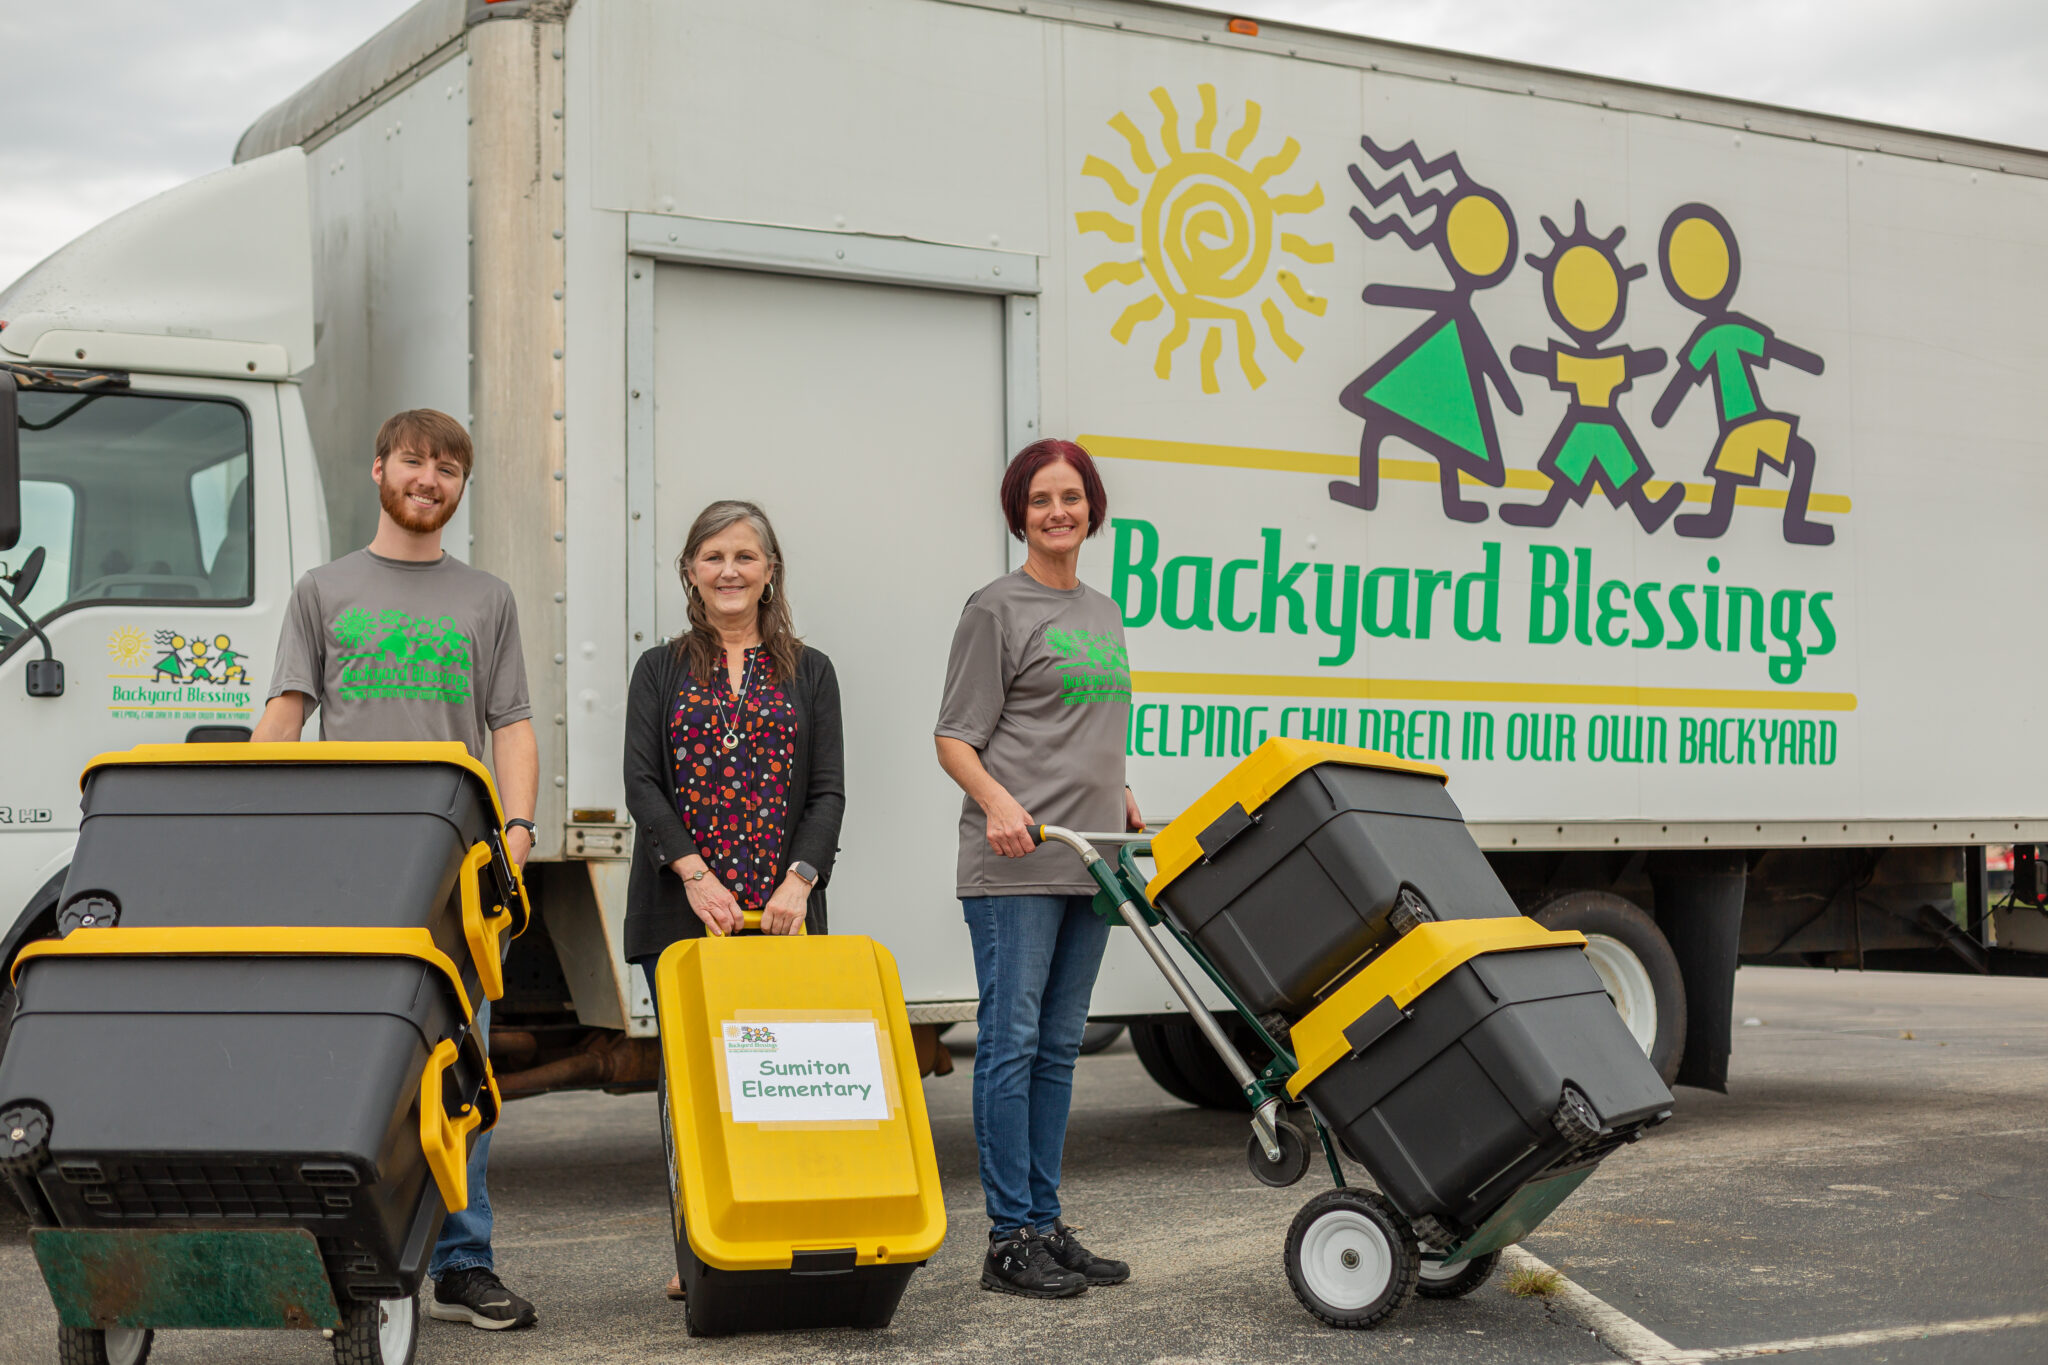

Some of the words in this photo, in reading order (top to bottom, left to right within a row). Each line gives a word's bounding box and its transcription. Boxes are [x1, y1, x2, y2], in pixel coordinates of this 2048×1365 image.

[1111, 517, 1502, 666] Backyard
[1529, 544, 1837, 685] Blessings
[342, 664, 408, 685] Backyard
[412, 665, 469, 691] Blessings
[1062, 671, 1114, 691] Backyard
[112, 685, 182, 706] Backyard
[187, 687, 251, 707] Blessings
[1280, 707, 1450, 760] CHILDREN
[1461, 711, 1494, 761] IN
[1506, 713, 1576, 762] OUR
[1587, 715, 1667, 764] OWN
[1679, 717, 1837, 765] BACKYARD
[19, 808, 52, 823] HD
[759, 1060, 850, 1076] Sumiton
[742, 1080, 872, 1101] Elementary
